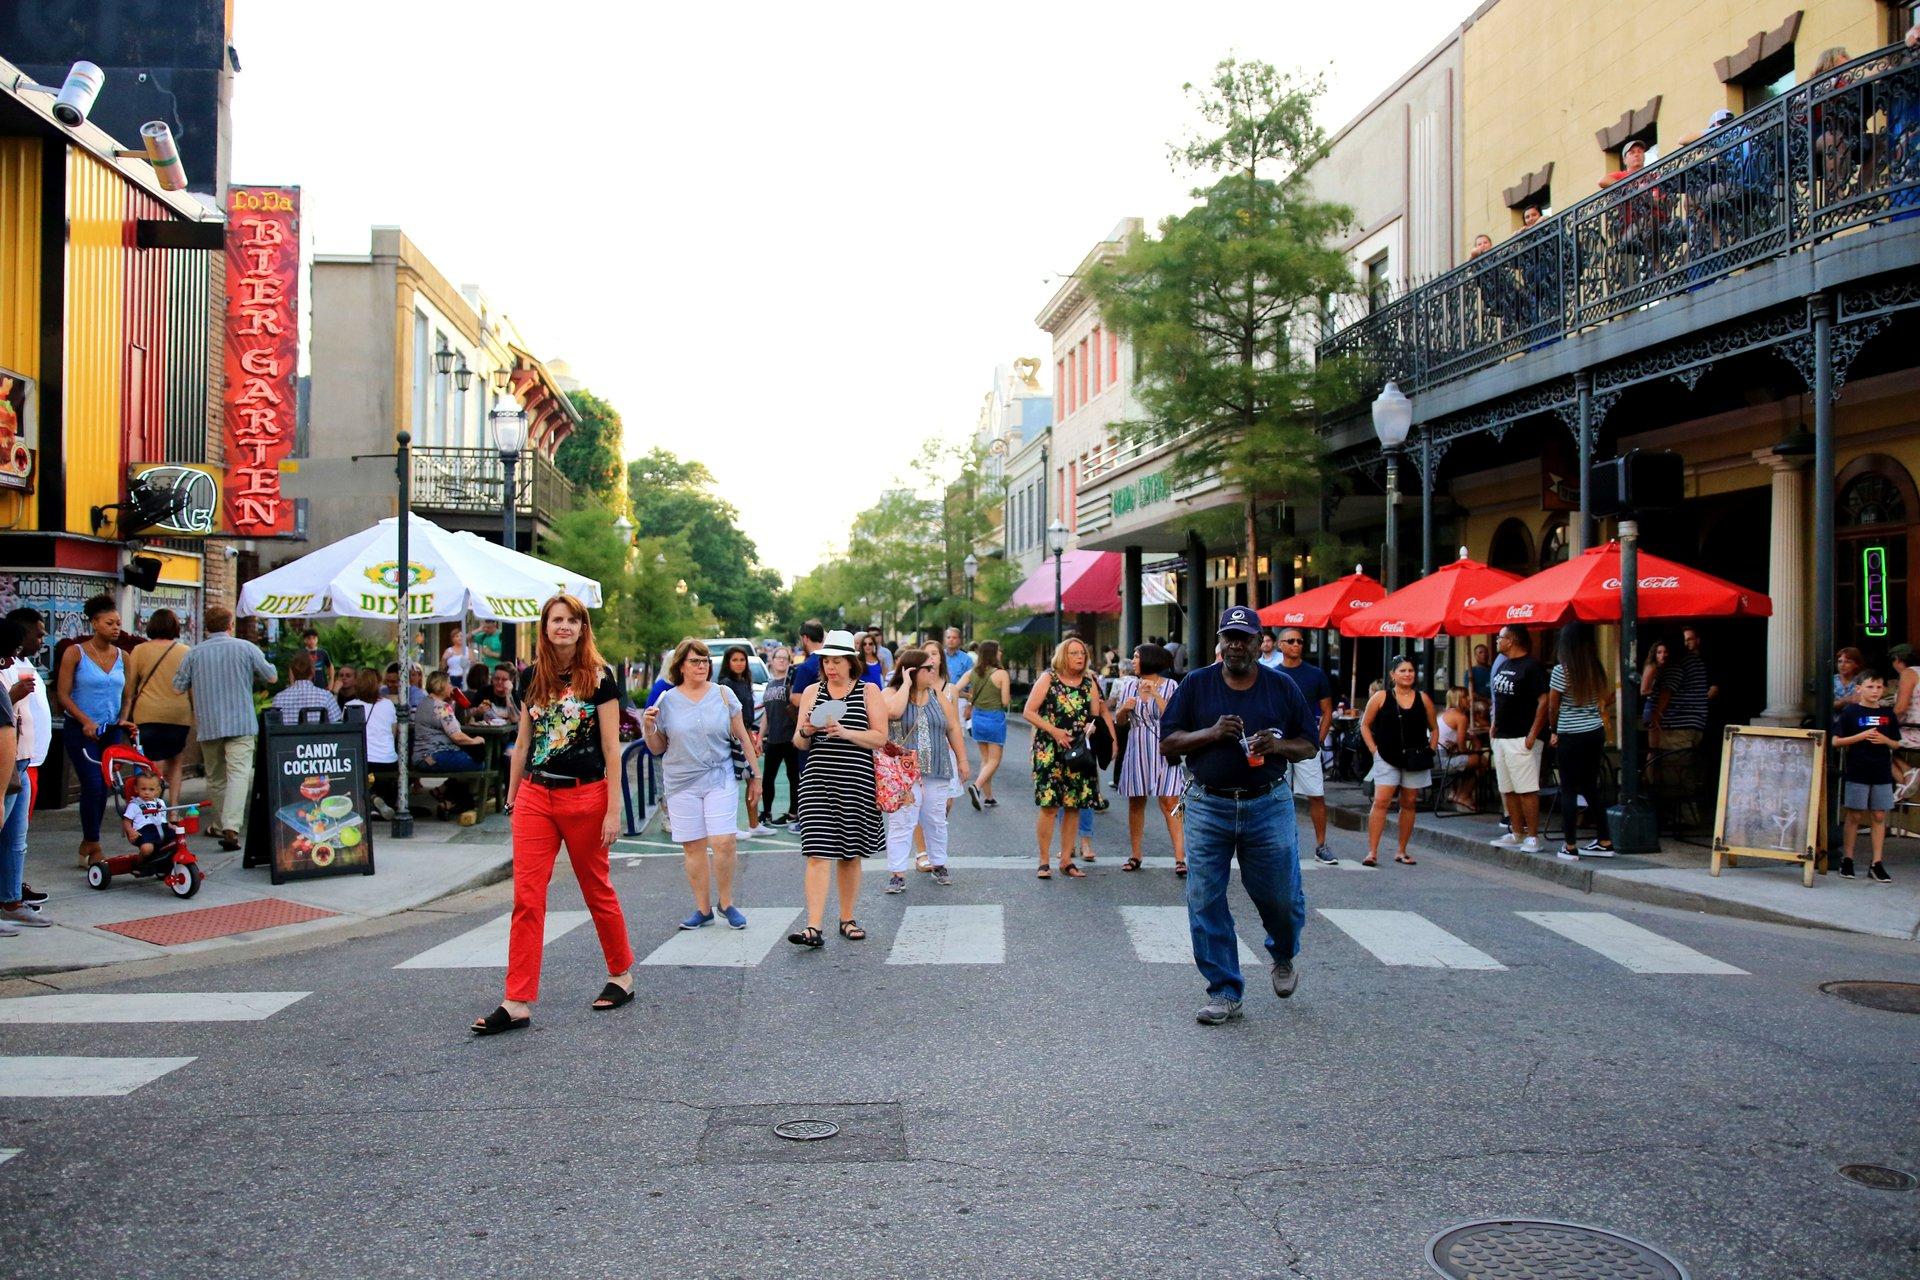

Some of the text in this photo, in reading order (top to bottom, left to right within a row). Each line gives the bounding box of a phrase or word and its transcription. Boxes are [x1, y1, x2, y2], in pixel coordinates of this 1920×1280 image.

[237, 218, 284, 336] BIER
[234, 347, 282, 526] GARTEN
[1869, 552, 1882, 630] OPEN
[256, 593, 314, 614] DIXIE
[485, 596, 541, 617] DIXIE
[296, 743, 338, 759] CANDY
[283, 758, 352, 775] COCKTAILS
